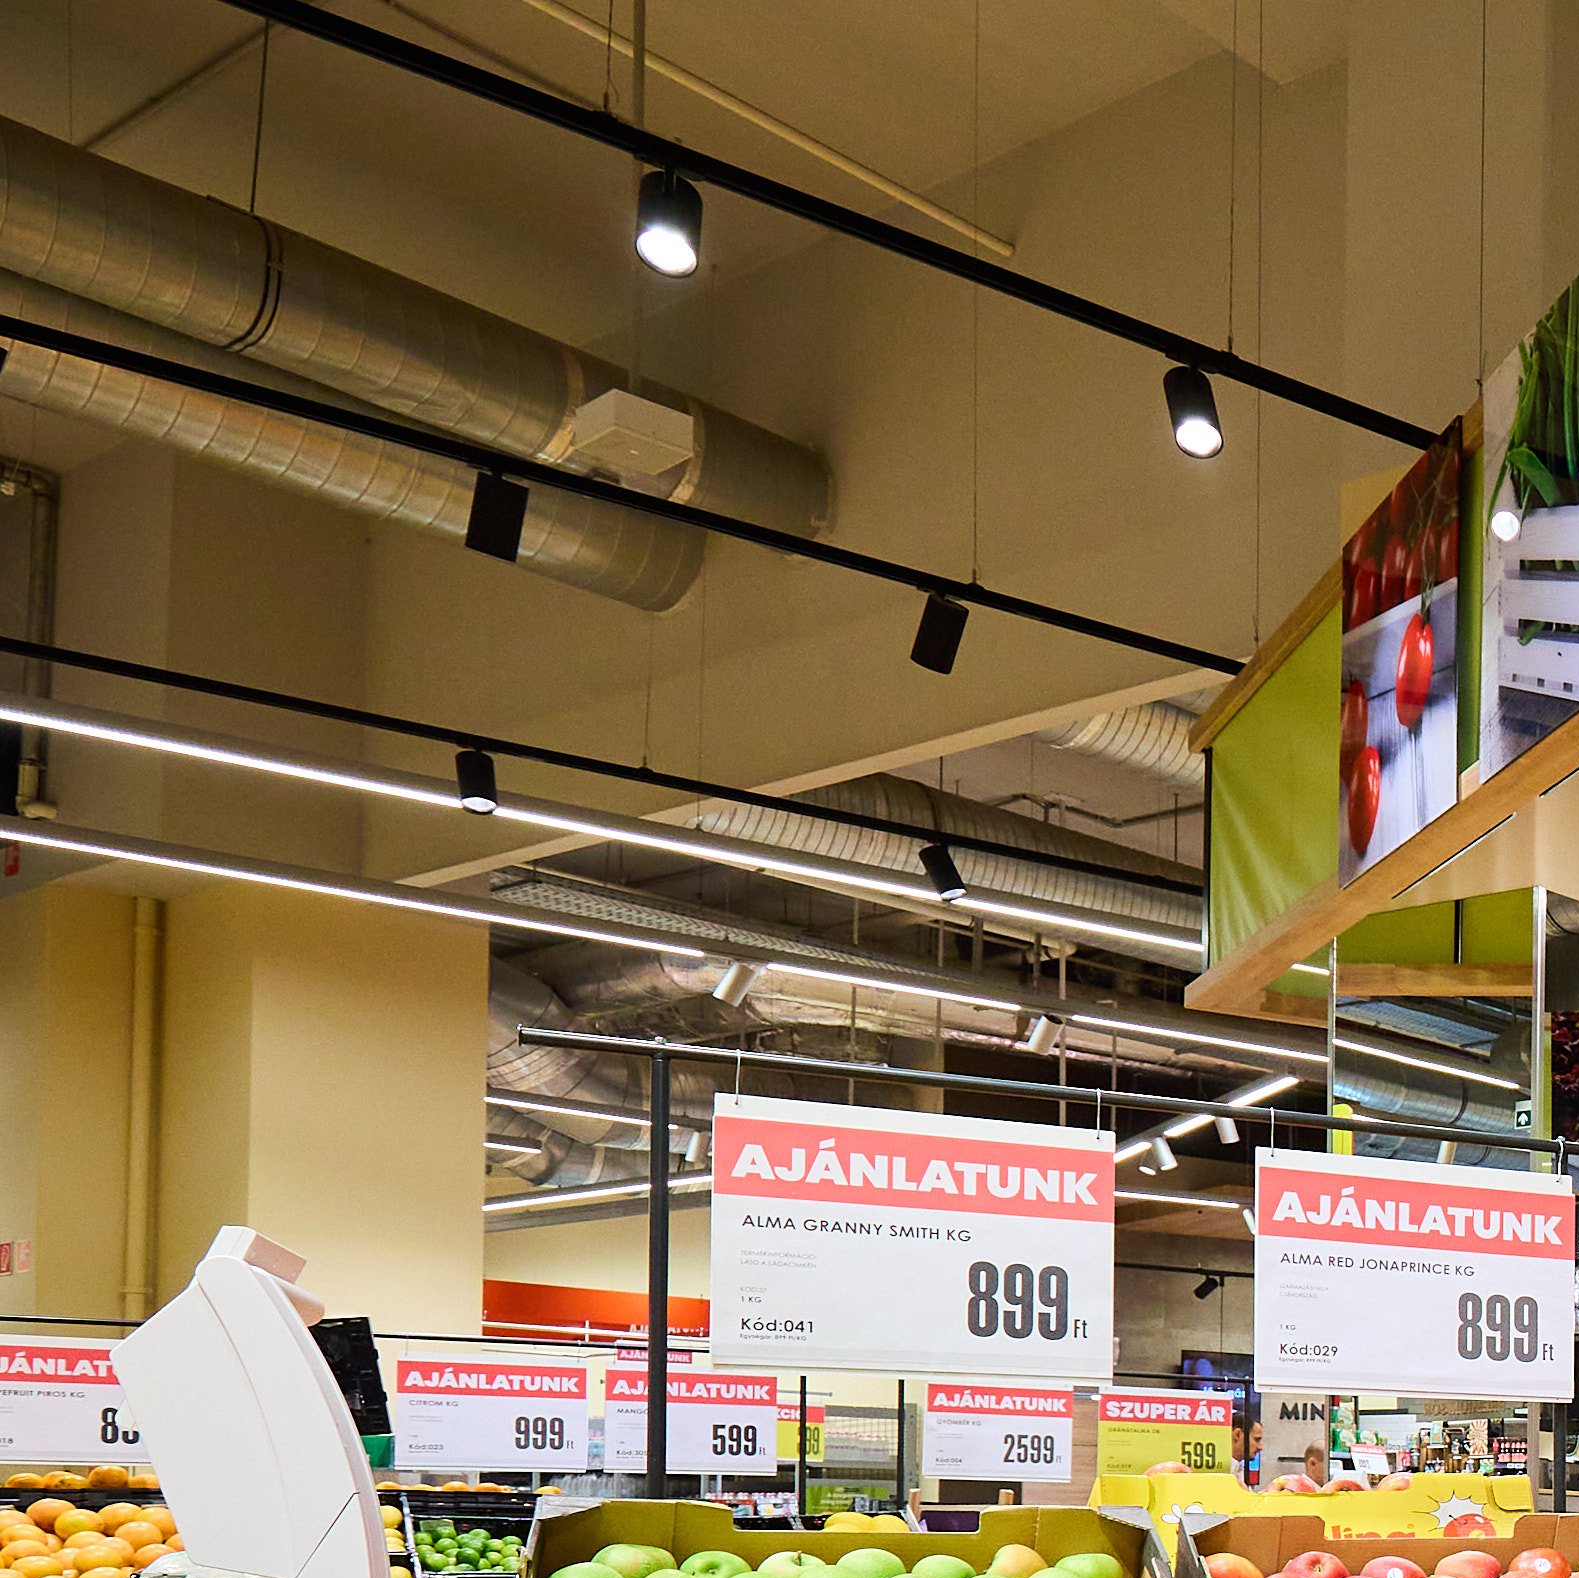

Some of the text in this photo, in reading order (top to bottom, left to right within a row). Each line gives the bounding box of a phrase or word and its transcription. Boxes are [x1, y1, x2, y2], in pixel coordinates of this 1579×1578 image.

[731, 1138, 1098, 1206] AJÁNLATUNK
[742, 1214, 972, 1242] ALMA GRANNY SMITH KG
[1272, 1186, 1564, 1246] AJÁNLATUNK
[1280, 1252, 1475, 1277] ALMA RED JONAPRINCE KG
[968, 1261, 1088, 1341] 899 Ft
[740, 1318, 815, 1334] Kód:041
[1285, 1324, 1297, 1332] KG
[1458, 1292, 1555, 1363] 899 Ft
[1279, 1342, 1339, 1358] Kód:029
[404, 1367, 579, 1393] AJÁNLATUNK
[612, 1380, 771, 1401] AJNLATUNK
[37, 1390, 67, 1398] PIROS
[933, 1391, 1067, 1413] AJÁNLATUNK
[1105, 1400, 1226, 1422] SZUPER ÁR
[1279, 1402, 1325, 1421] MIN
[515, 1416, 575, 1450] 999 Ft
[712, 1424, 767, 1456] 599 Ft
[1003, 1434, 1055, 1464] 2599
[1180, 1441, 1216, 1470] 599
